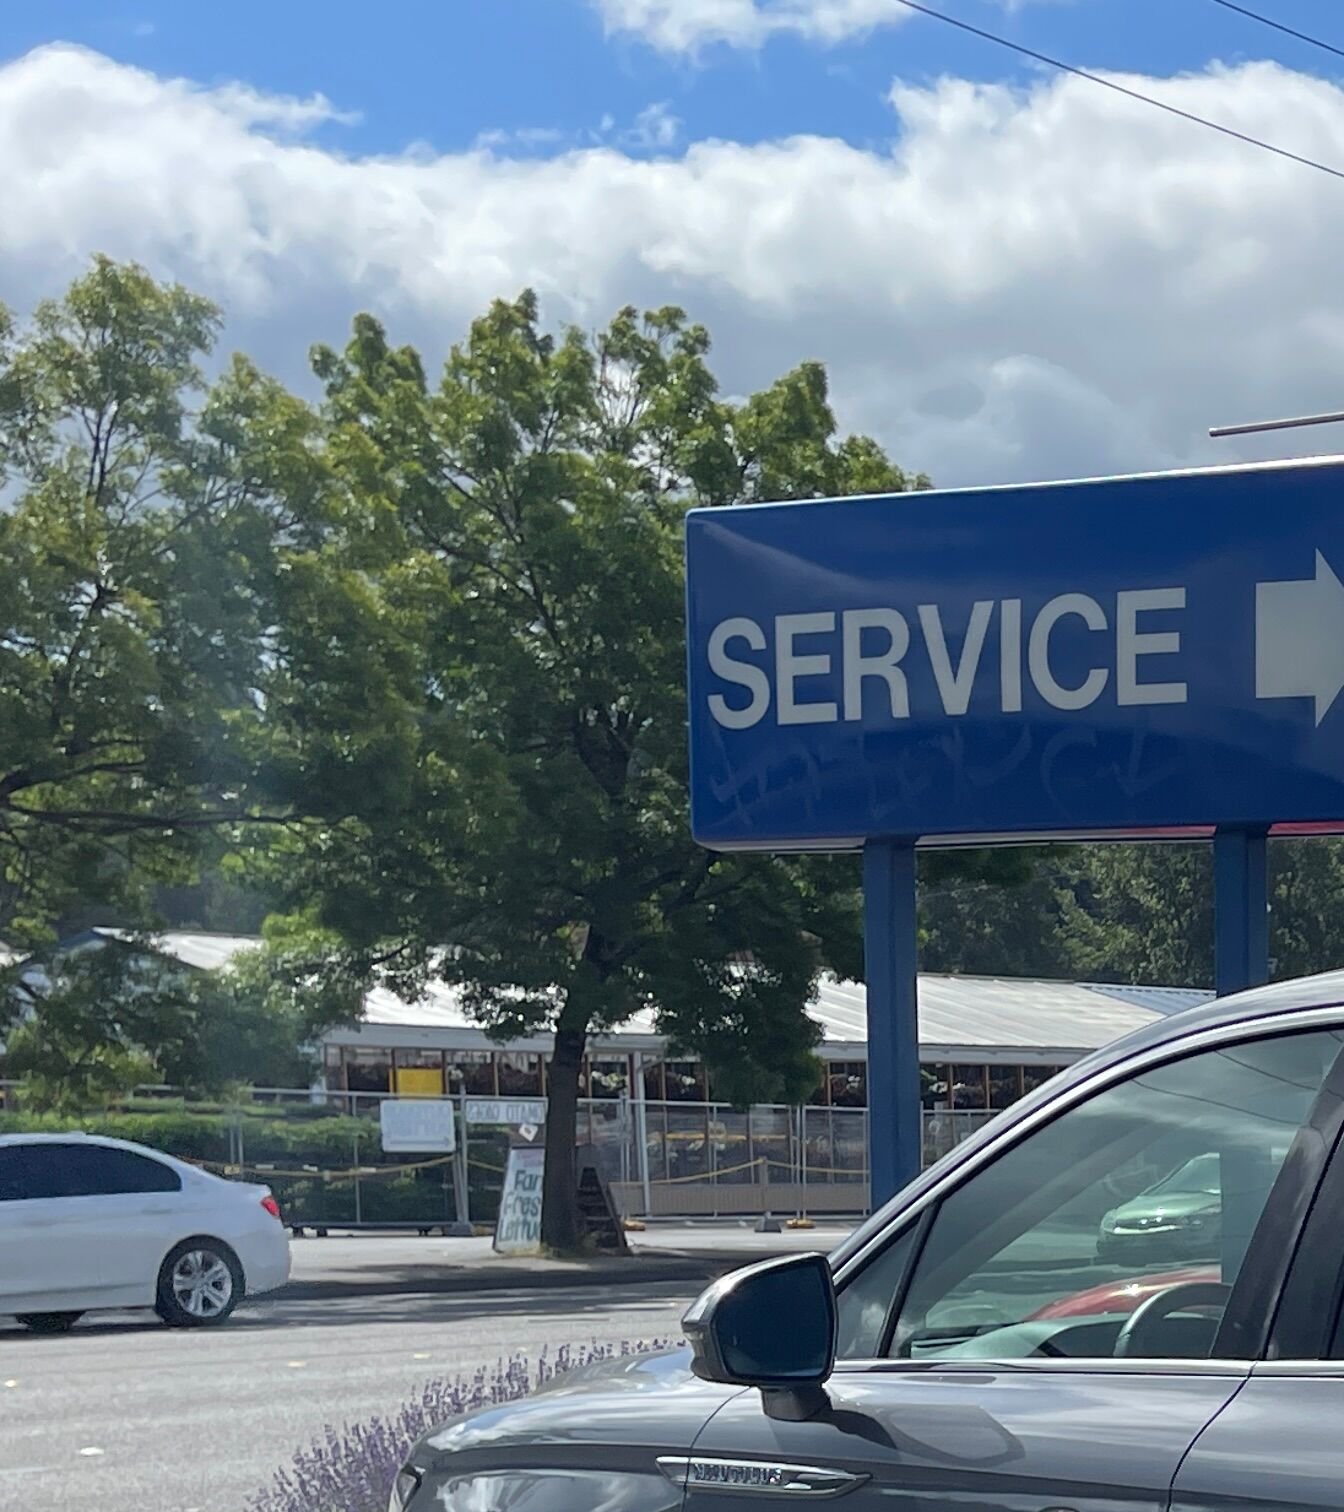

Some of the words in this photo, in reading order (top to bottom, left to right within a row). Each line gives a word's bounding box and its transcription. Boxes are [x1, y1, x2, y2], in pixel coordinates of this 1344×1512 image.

[707, 587, 1189, 730] SERVICE
[514, 1169, 541, 1191] Far
[503, 1192, 541, 1217] Fres
